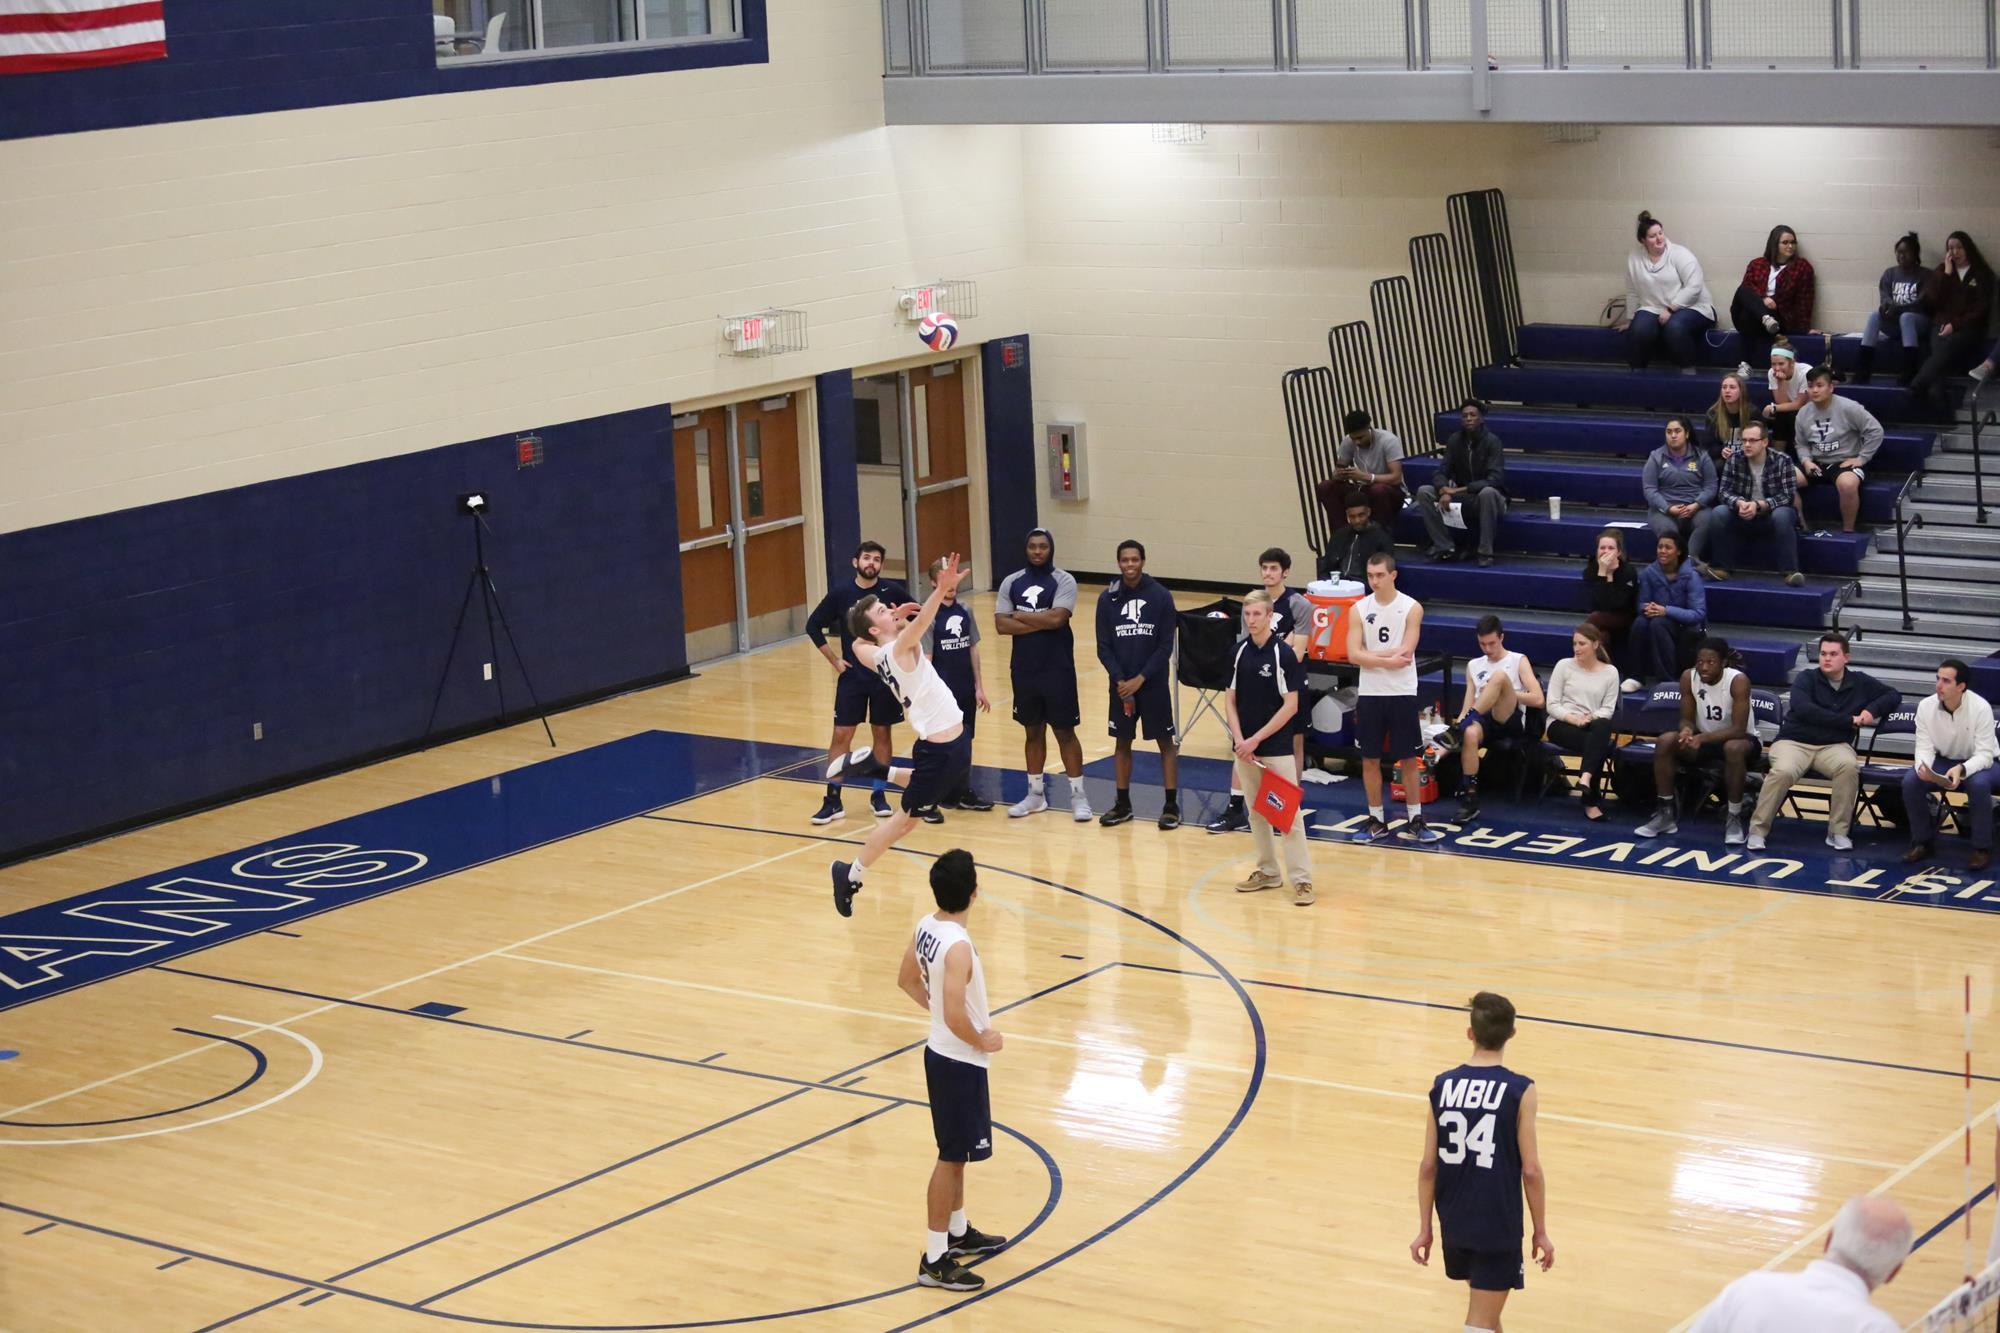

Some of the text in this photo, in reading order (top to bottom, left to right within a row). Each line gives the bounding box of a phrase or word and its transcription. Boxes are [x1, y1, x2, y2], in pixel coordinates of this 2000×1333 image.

[916, 288, 933, 310] EXIT
[743, 318, 761, 340] EXIT
[1313, 607, 1329, 628] G
[1378, 626, 1390, 643] 6
[1706, 705, 1723, 721] 13
[1825, 868, 2000, 903] IST
[916, 927, 942, 963] MBU
[1439, 1078, 1508, 1110] MBU
[1438, 1110, 1497, 1169] 34
